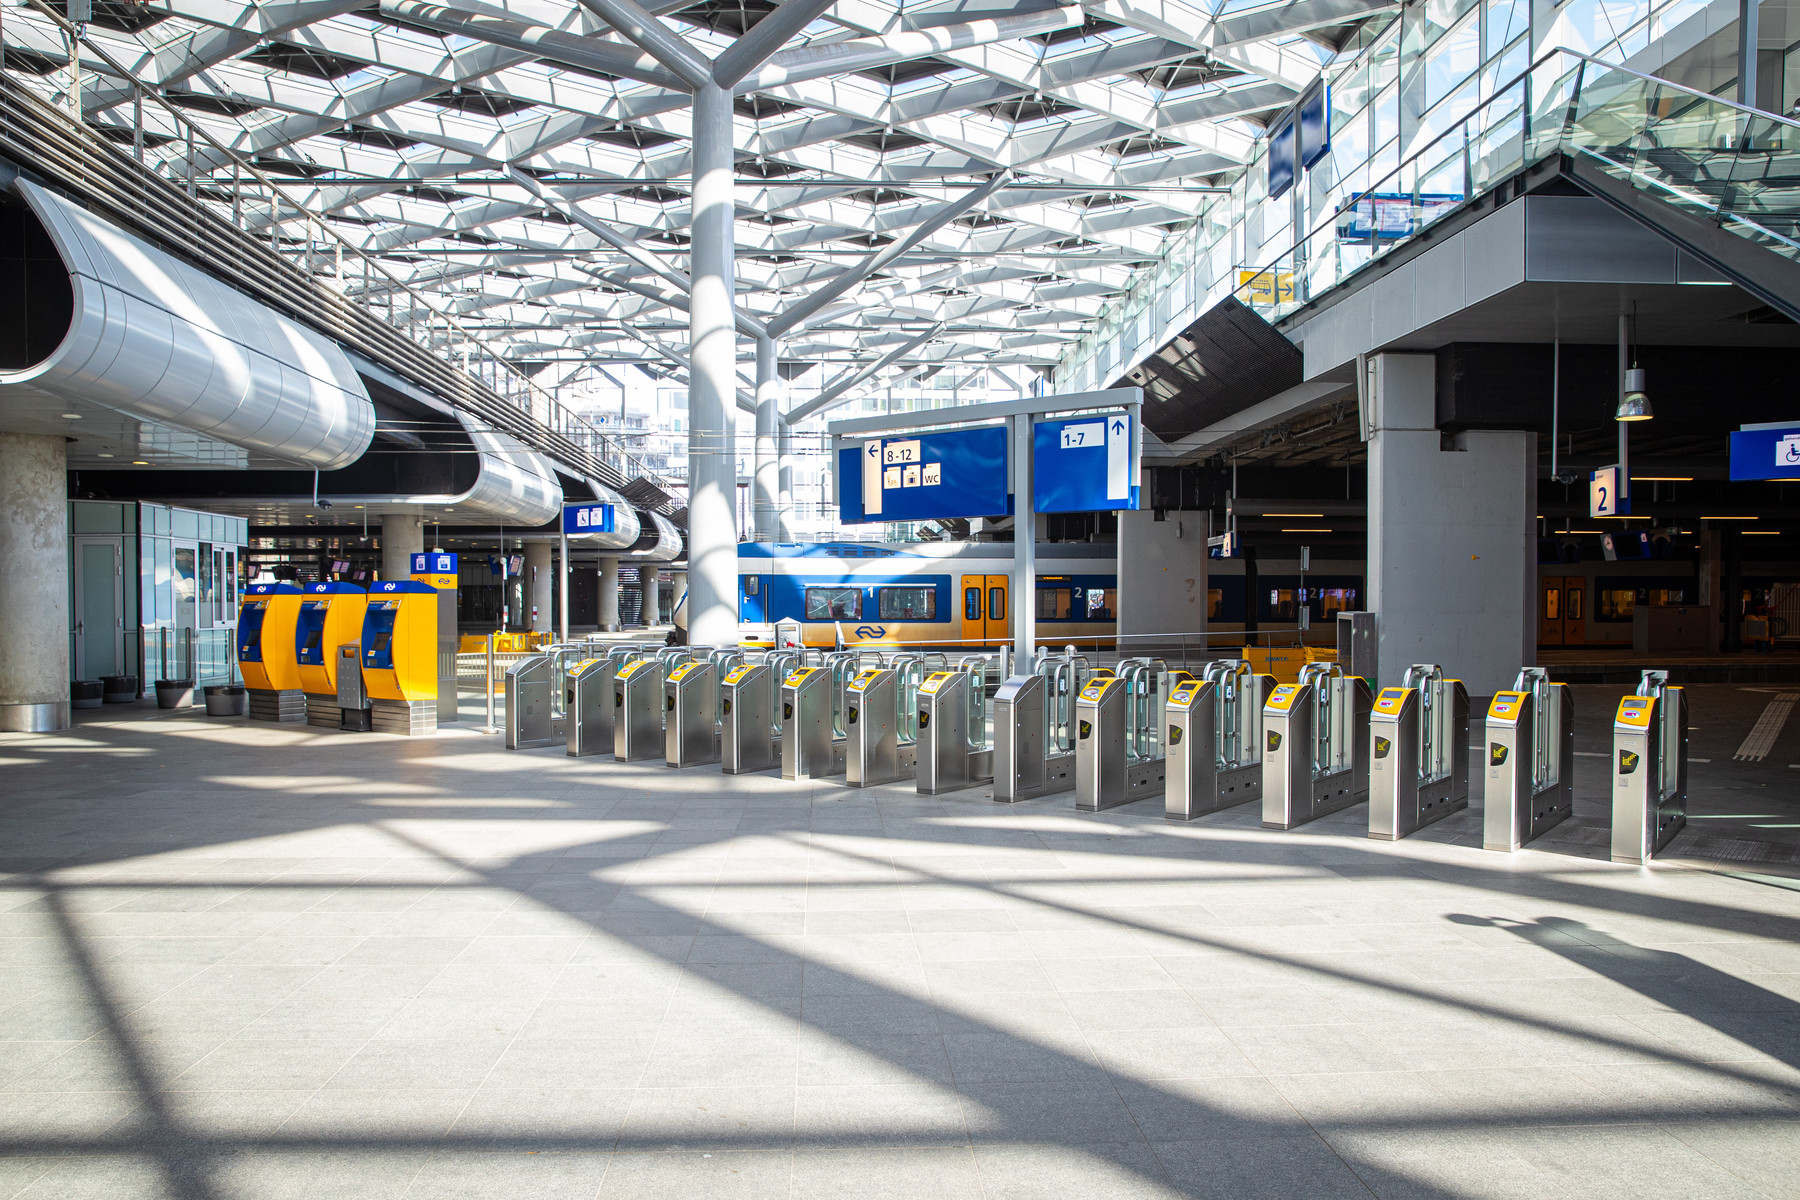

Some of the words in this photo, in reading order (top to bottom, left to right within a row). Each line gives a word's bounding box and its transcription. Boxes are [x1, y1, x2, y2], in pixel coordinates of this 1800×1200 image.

[1064, 432, 1085, 446] 1-7
[924, 474, 939, 484] WC
[1597, 486, 1608, 512] 2
[867, 586, 874, 599] 1
[1074, 586, 1083, 599] 2
[1309, 587, 1317, 599] 2
[1639, 587, 1647, 599] 2
